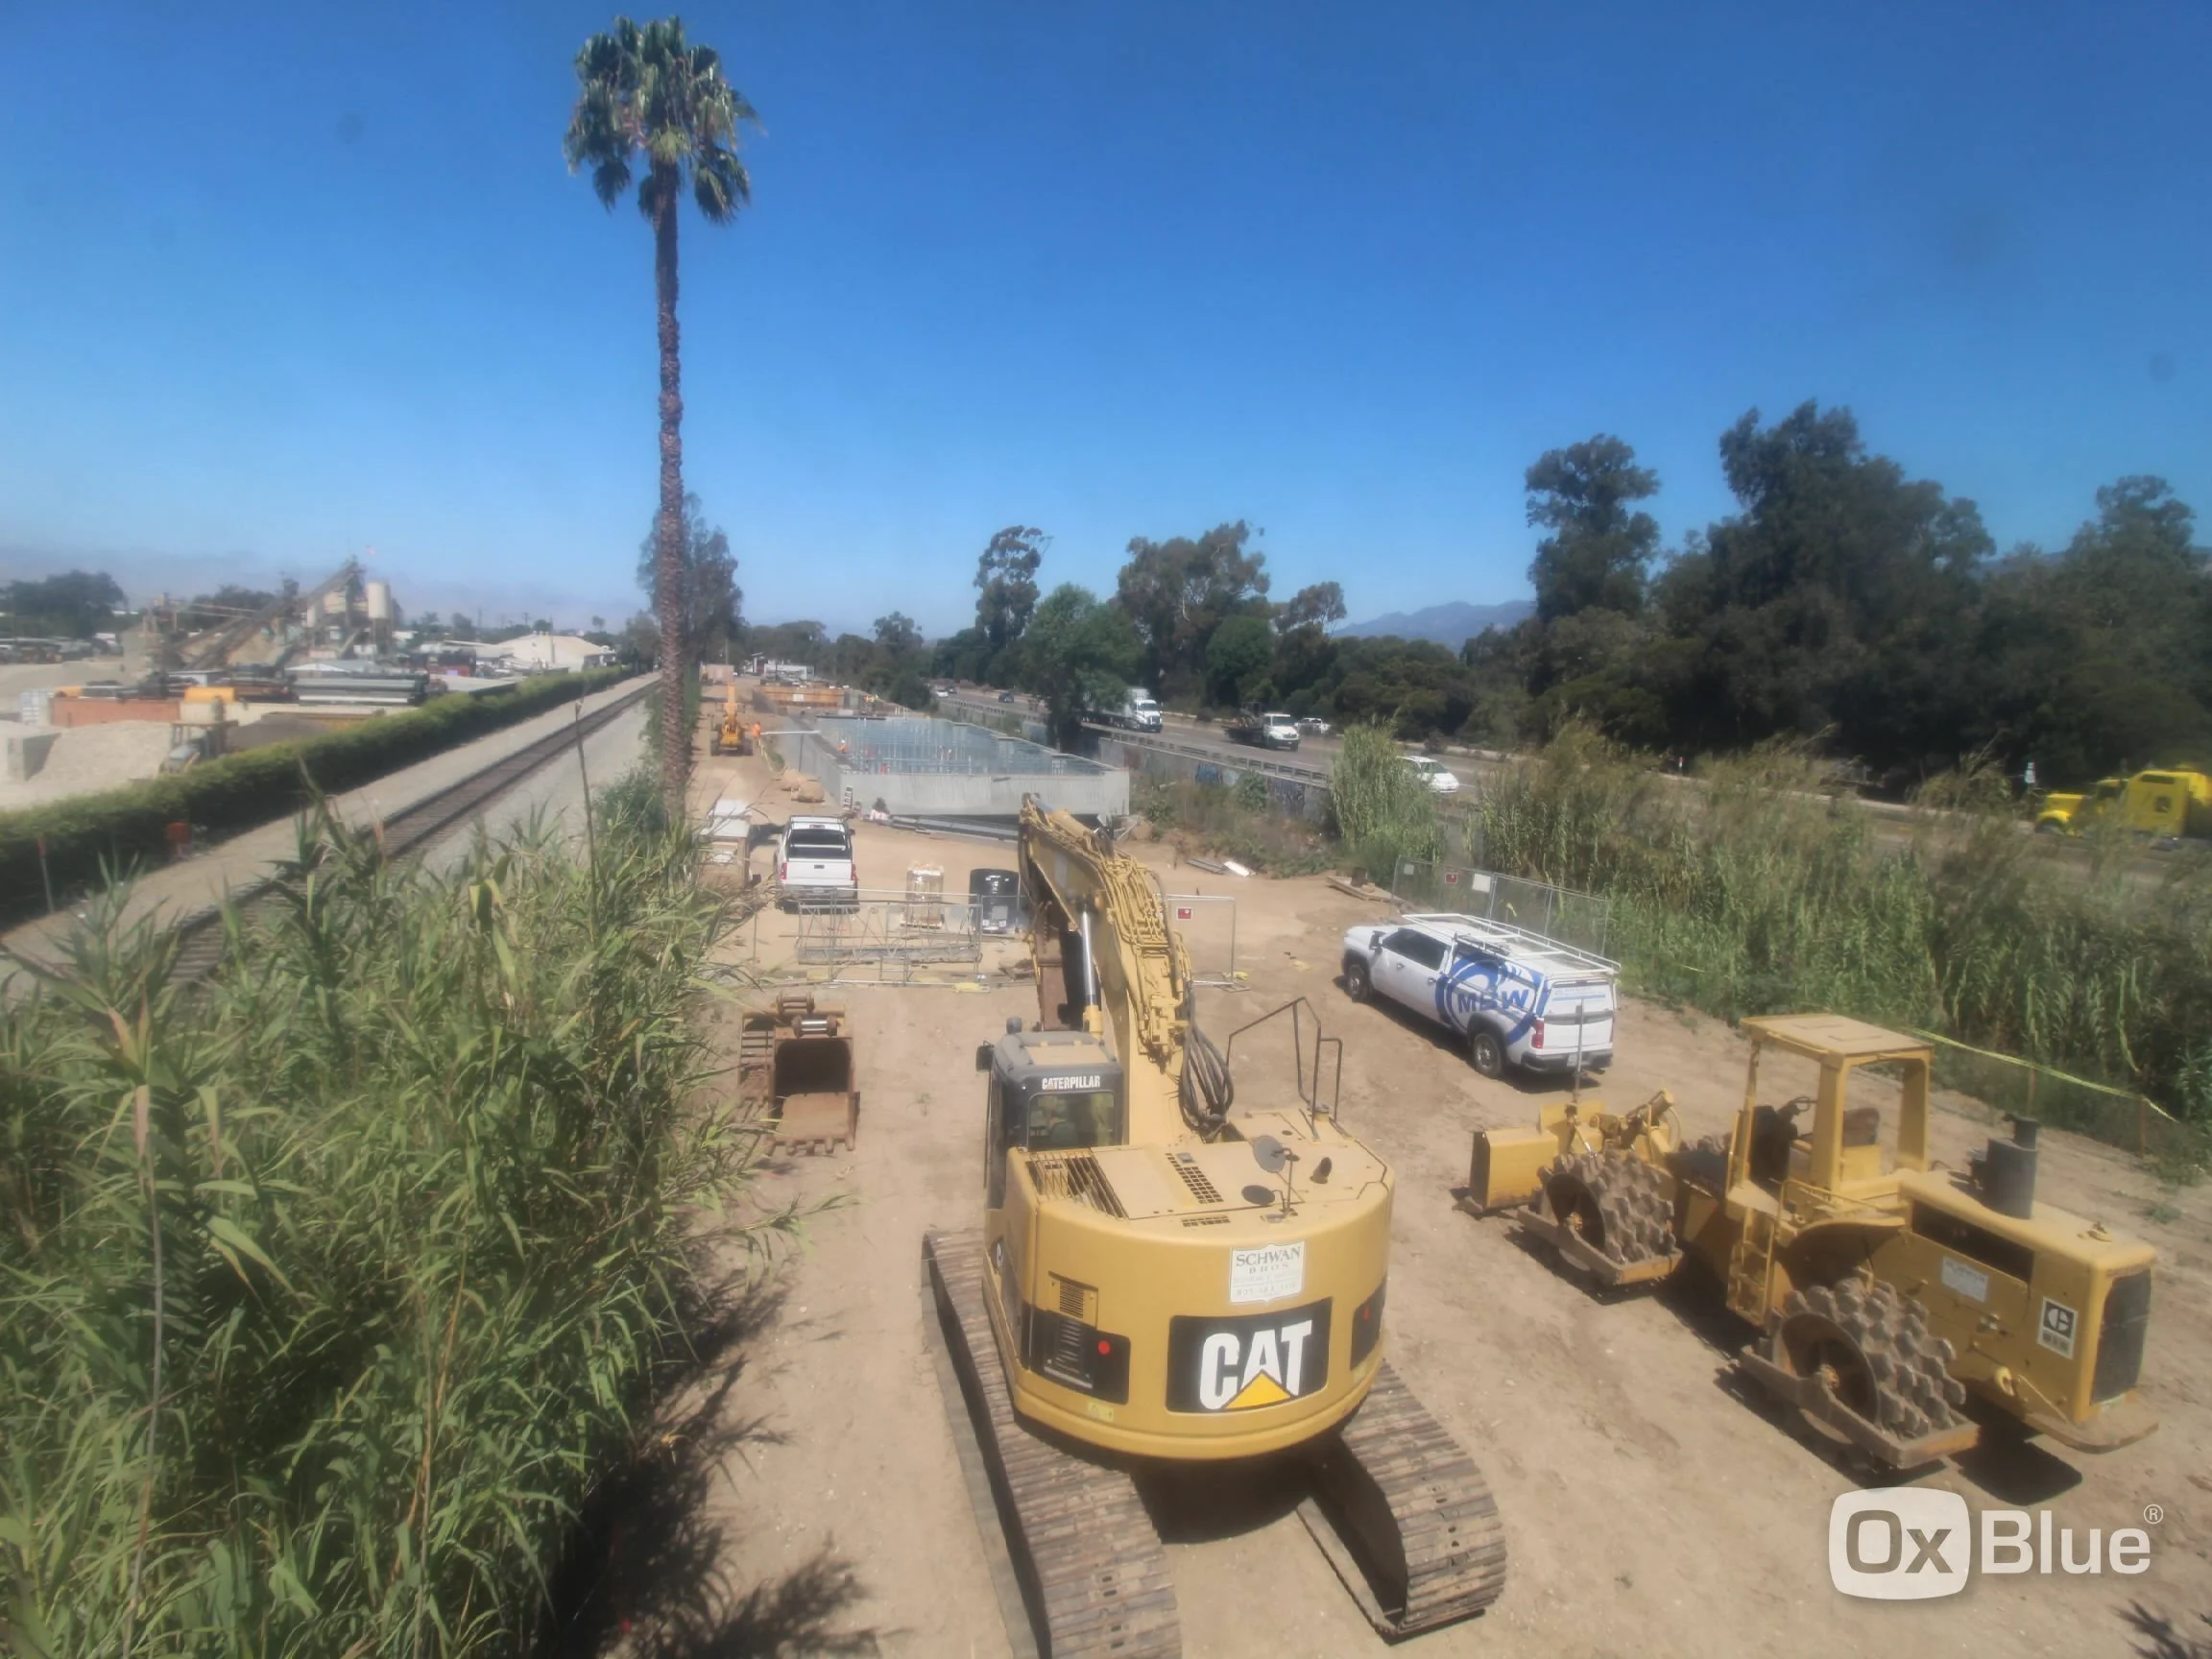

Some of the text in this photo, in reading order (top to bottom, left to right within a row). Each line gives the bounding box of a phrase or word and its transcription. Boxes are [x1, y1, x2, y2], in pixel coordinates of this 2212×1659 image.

[1042, 1075, 1100, 1090] CATERPILLAR
[1236, 1246, 1301, 1266] SCHWAN
[1199, 1319, 1312, 1409] CAT
